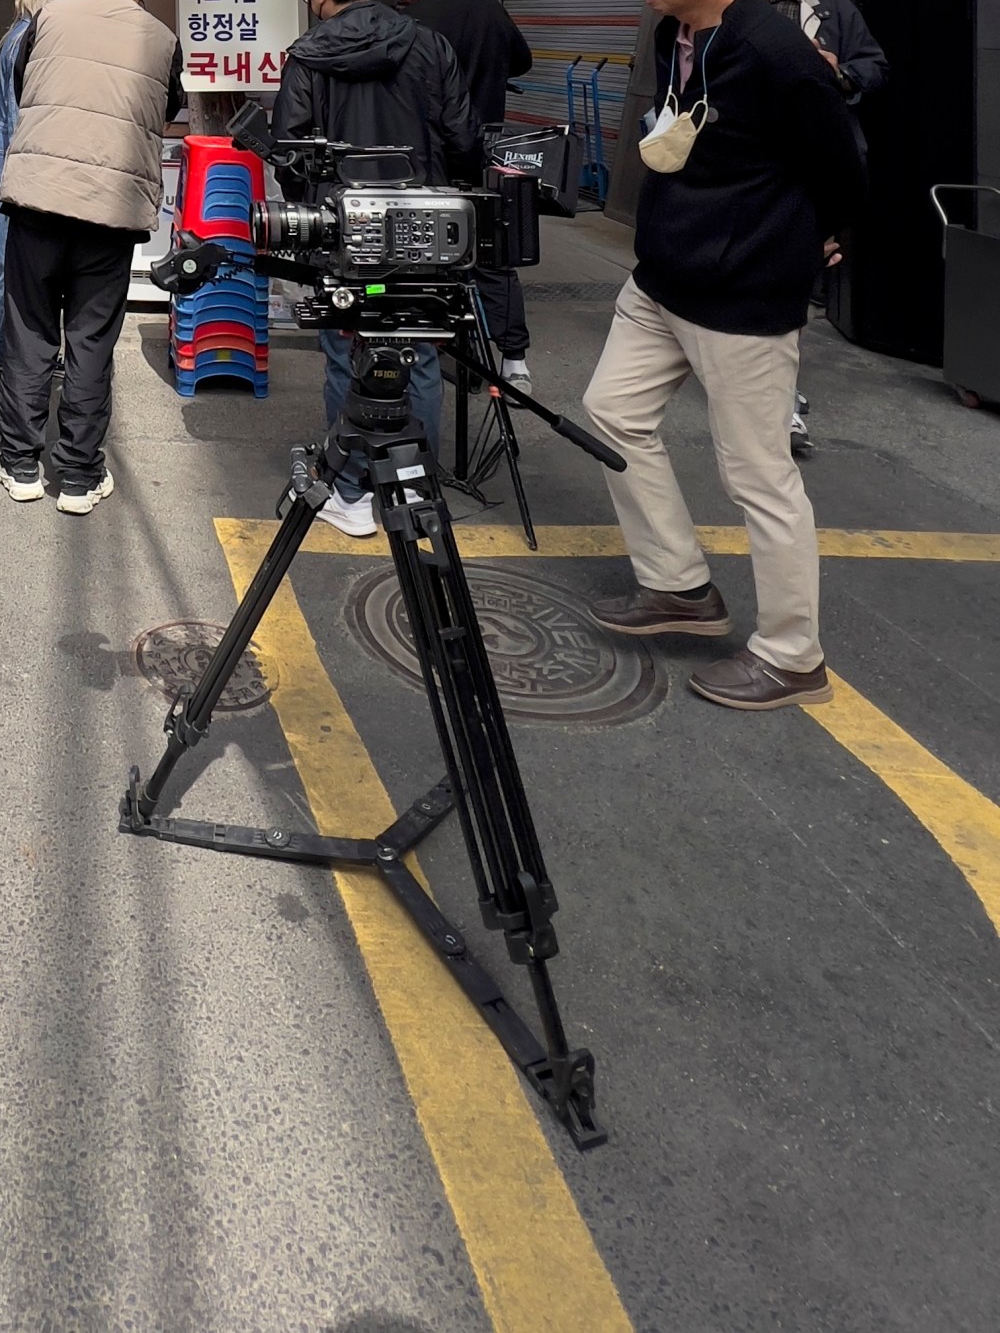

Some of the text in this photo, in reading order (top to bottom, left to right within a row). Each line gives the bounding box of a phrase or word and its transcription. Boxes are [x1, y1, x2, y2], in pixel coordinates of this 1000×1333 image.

[187, 12, 259, 42] 항정살
[186, 51, 289, 84] 국내산
[503, 150, 543, 167] FLEXIBLE
